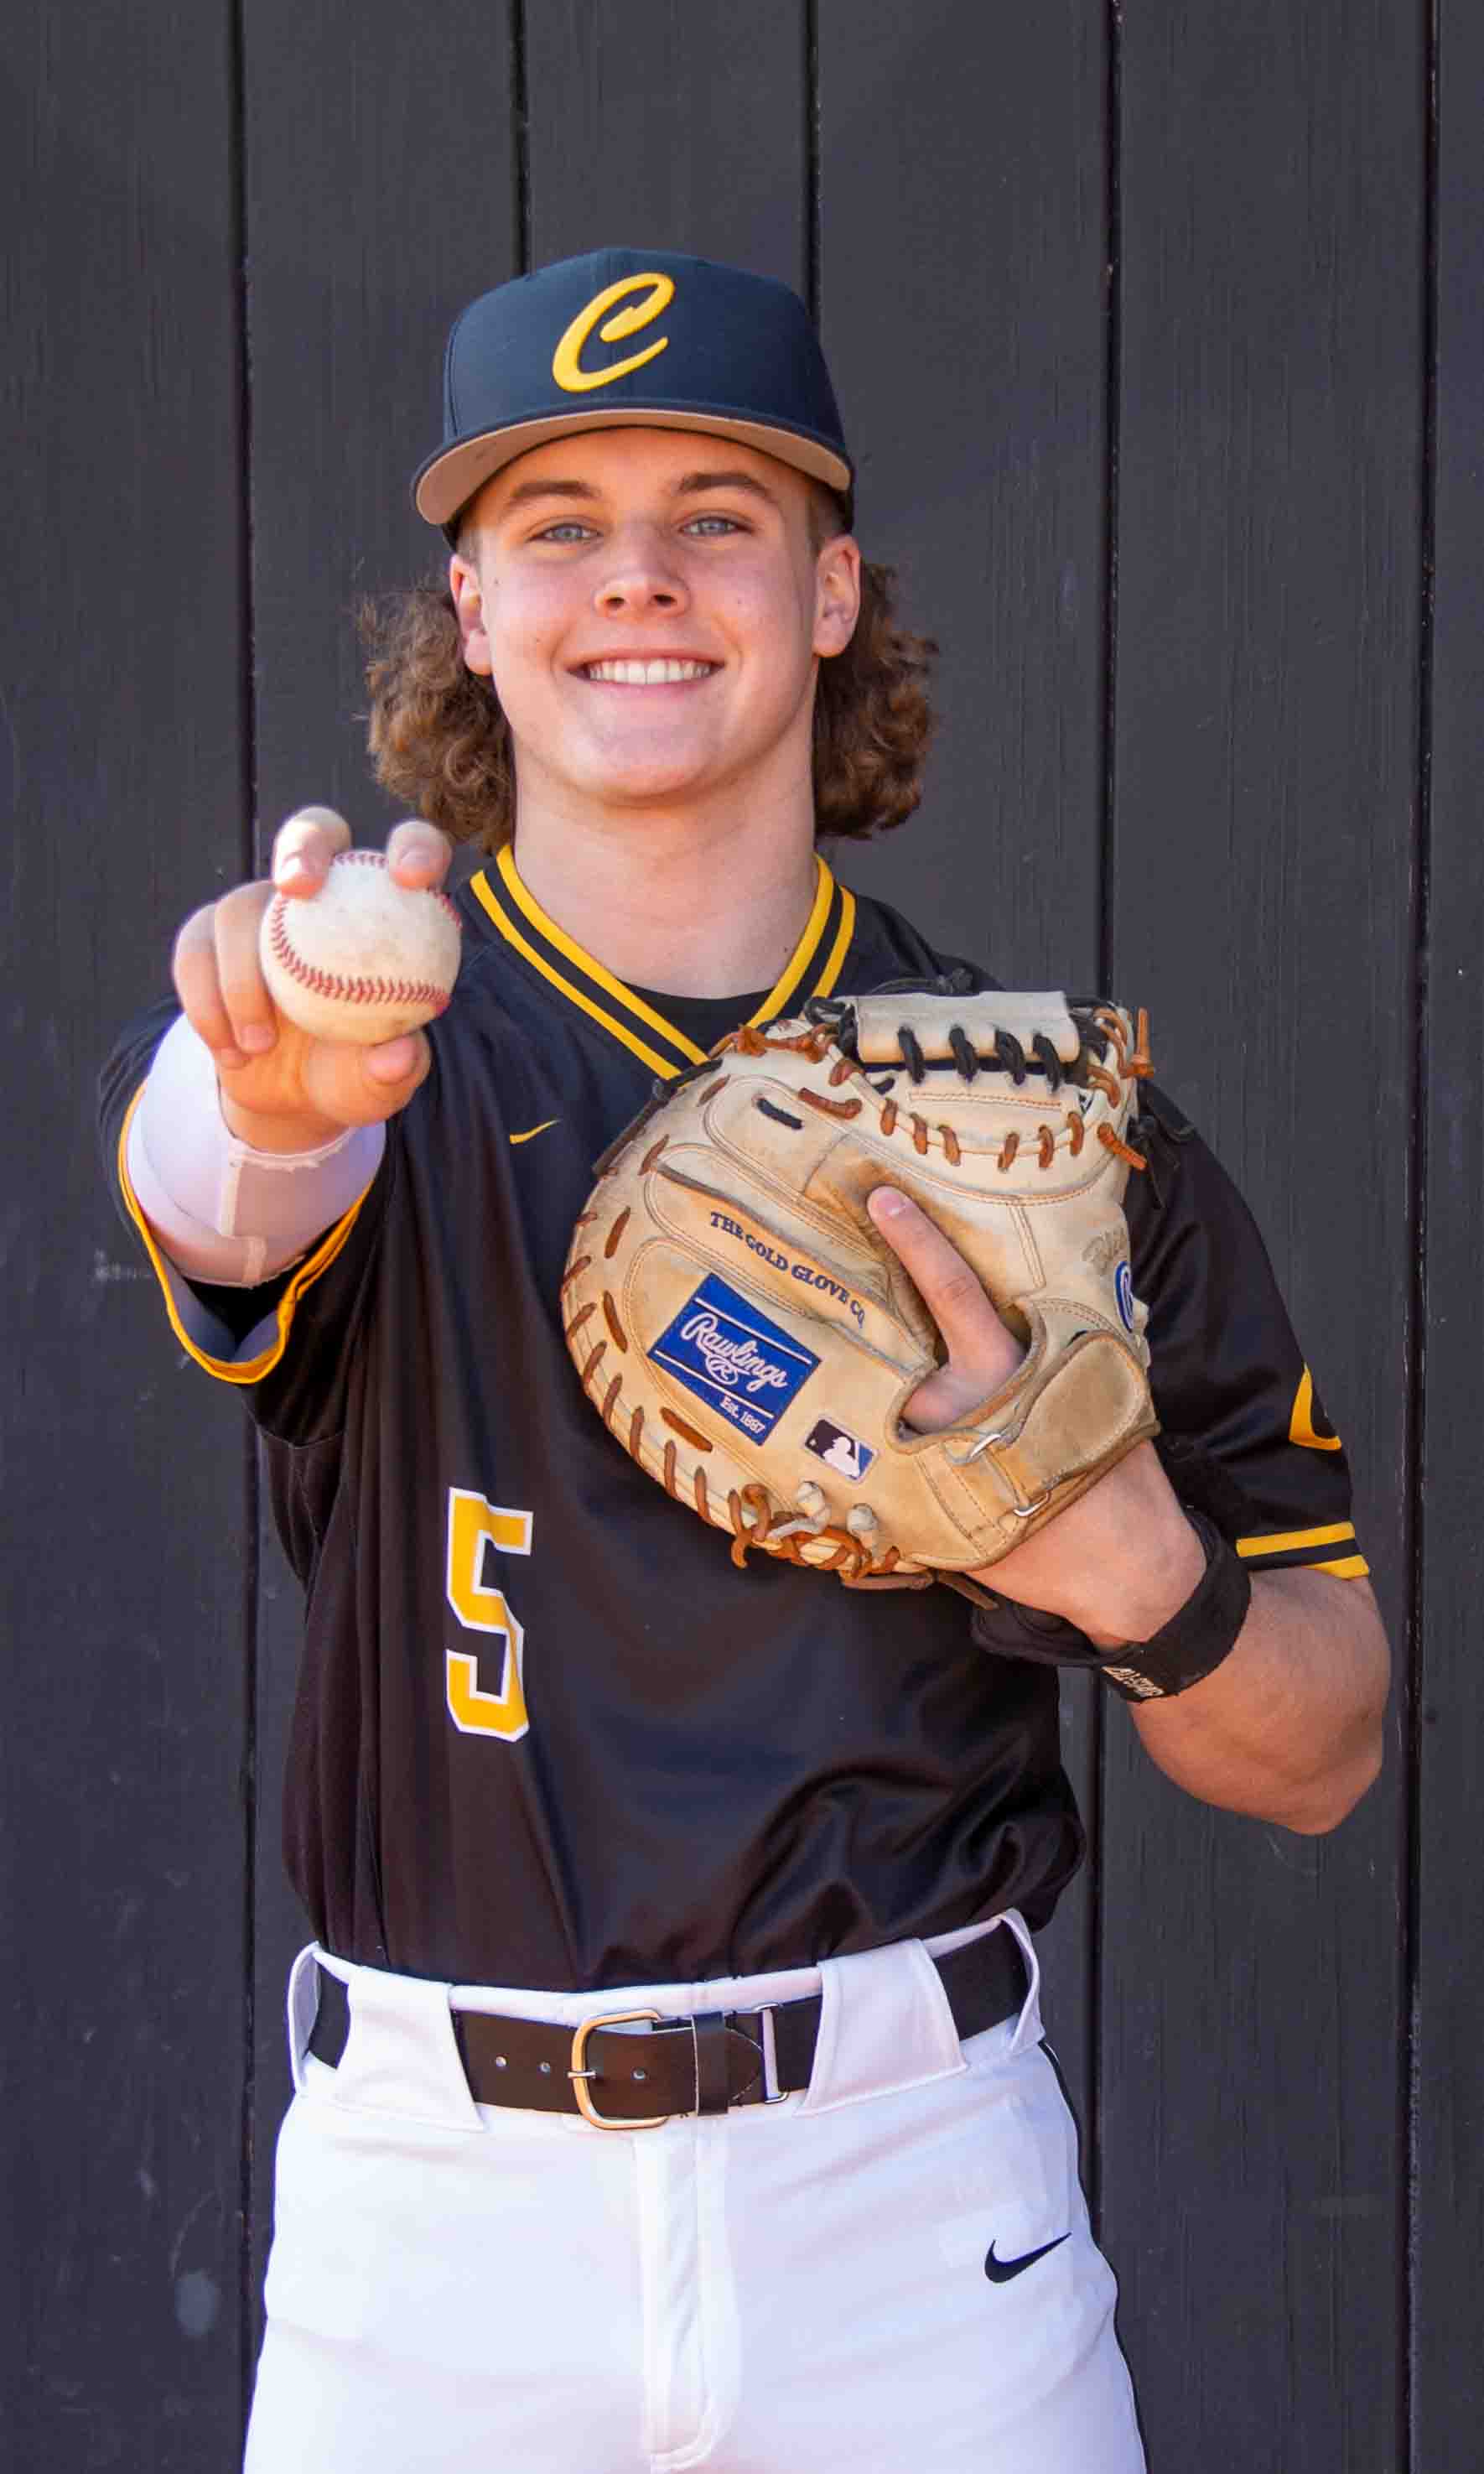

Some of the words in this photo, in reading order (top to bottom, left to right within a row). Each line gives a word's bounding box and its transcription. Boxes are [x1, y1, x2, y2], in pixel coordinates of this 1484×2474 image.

[711, 1211, 744, 1240] THE
[745, 1234, 789, 1271] GOLD
[791, 1264, 850, 1304] GLOVE
[680, 1312, 788, 1392] Rawlings
[446, 1487, 534, 1743] 5
